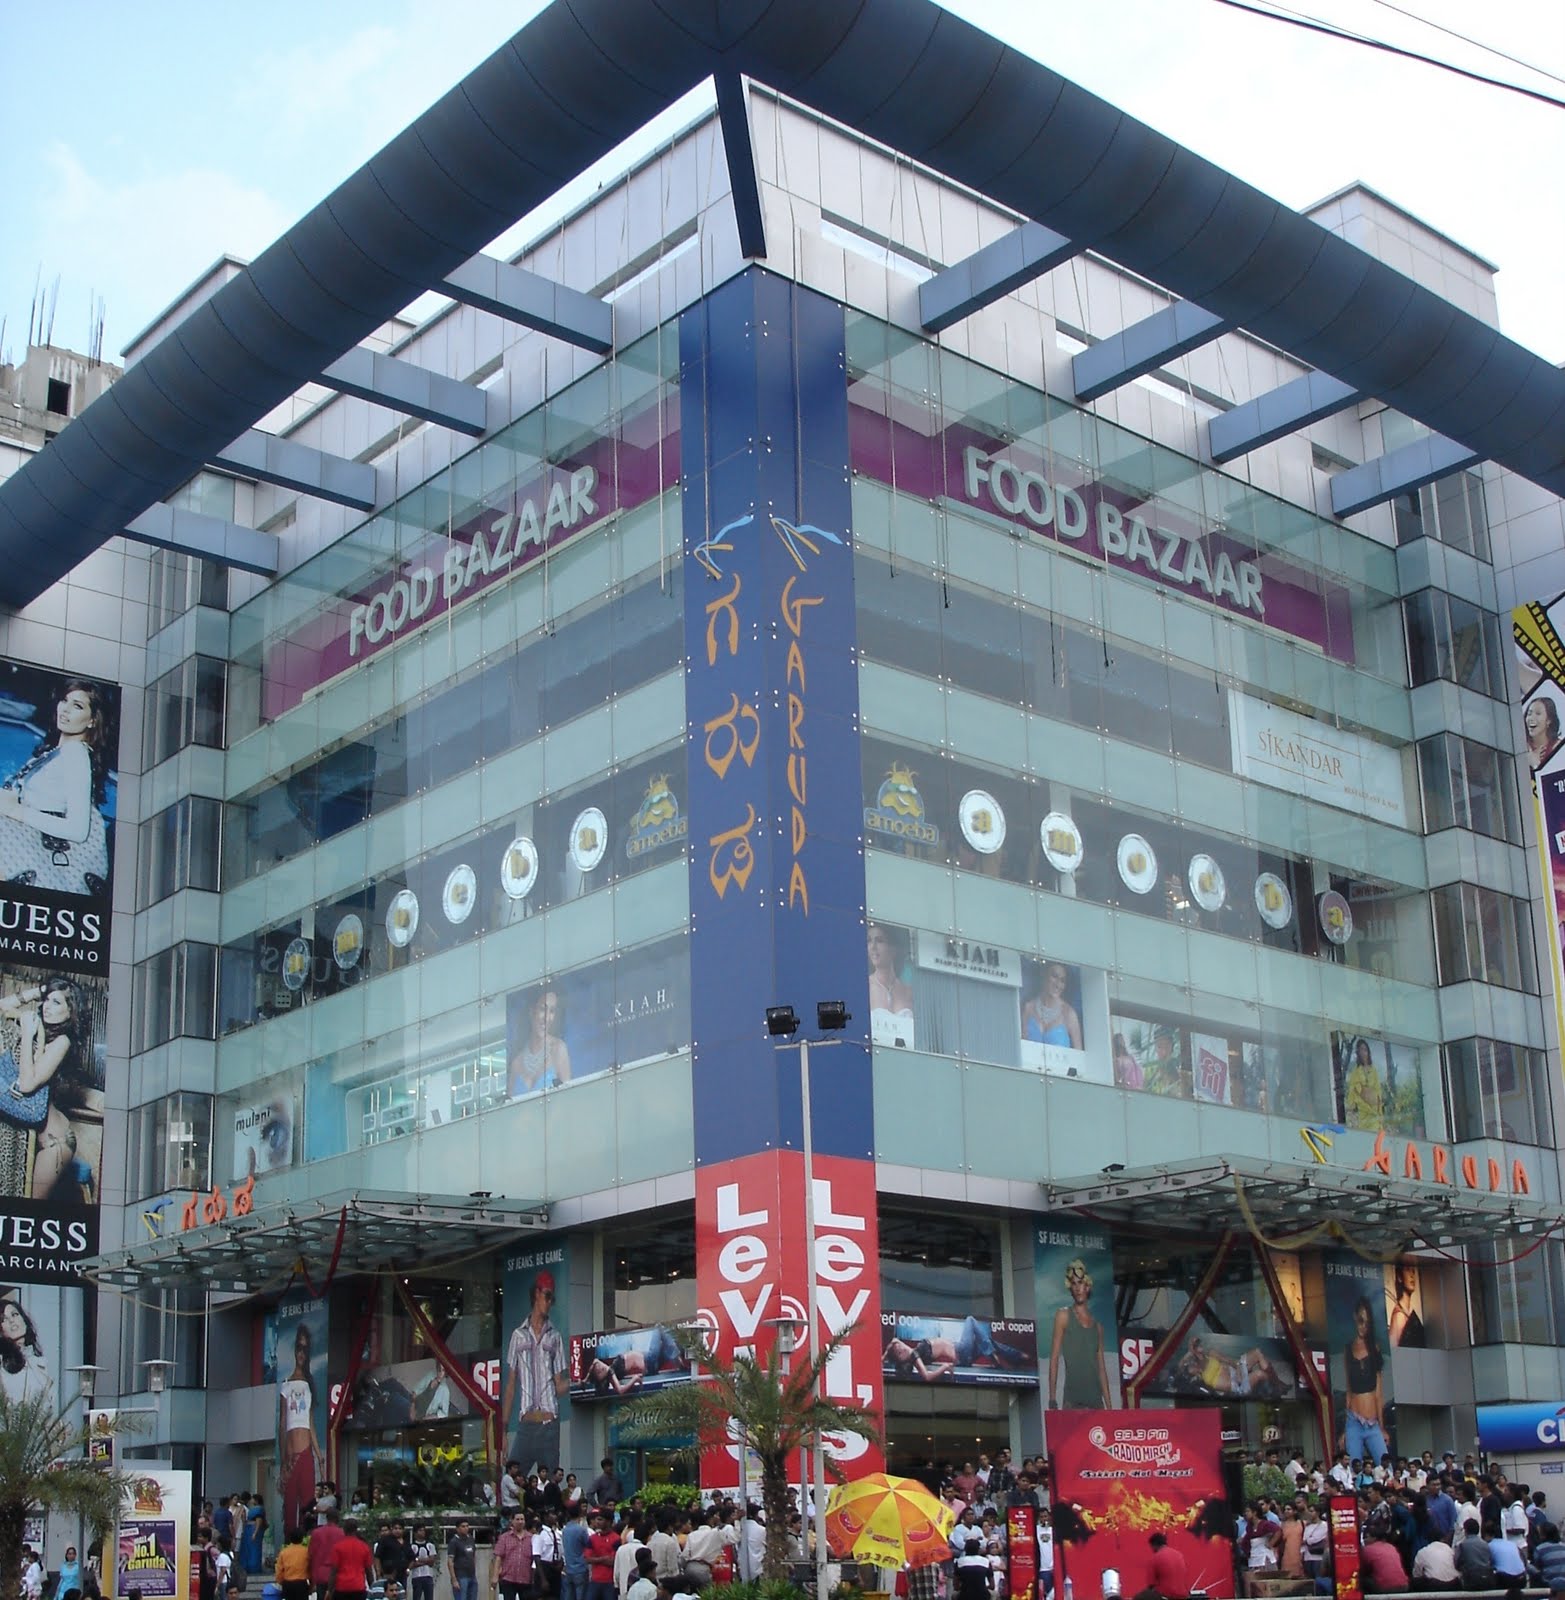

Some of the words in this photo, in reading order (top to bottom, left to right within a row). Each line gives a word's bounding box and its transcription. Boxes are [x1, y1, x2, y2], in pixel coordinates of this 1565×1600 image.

[963, 445, 1087, 538] FOOD
[1096, 501, 1265, 614] BAZAAR
[350, 567, 437, 656] FOOD
[443, 465, 599, 599] BAZAAR
[781, 575, 824, 919] GARUDA
[629, 818, 688, 854] amoeba
[867, 810, 936, 841] amoeba
[0, 937, 98, 962] MARCIANO
[945, 938, 1000, 968] KIAH
[614, 989, 666, 1018] KIAH
[1362, 1130, 1528, 1194] GARUDA
[536, 1253, 545, 1266] BE
[991, 1321, 1005, 1332] got
[582, 1334, 597, 1349] red
[1114, 1429, 1146, 1441] 93.3
[1147, 1429, 1168, 1440] FM
[1114, 1443, 1142, 1462] RADIO
[127, 1556, 166, 1571] Garuda
